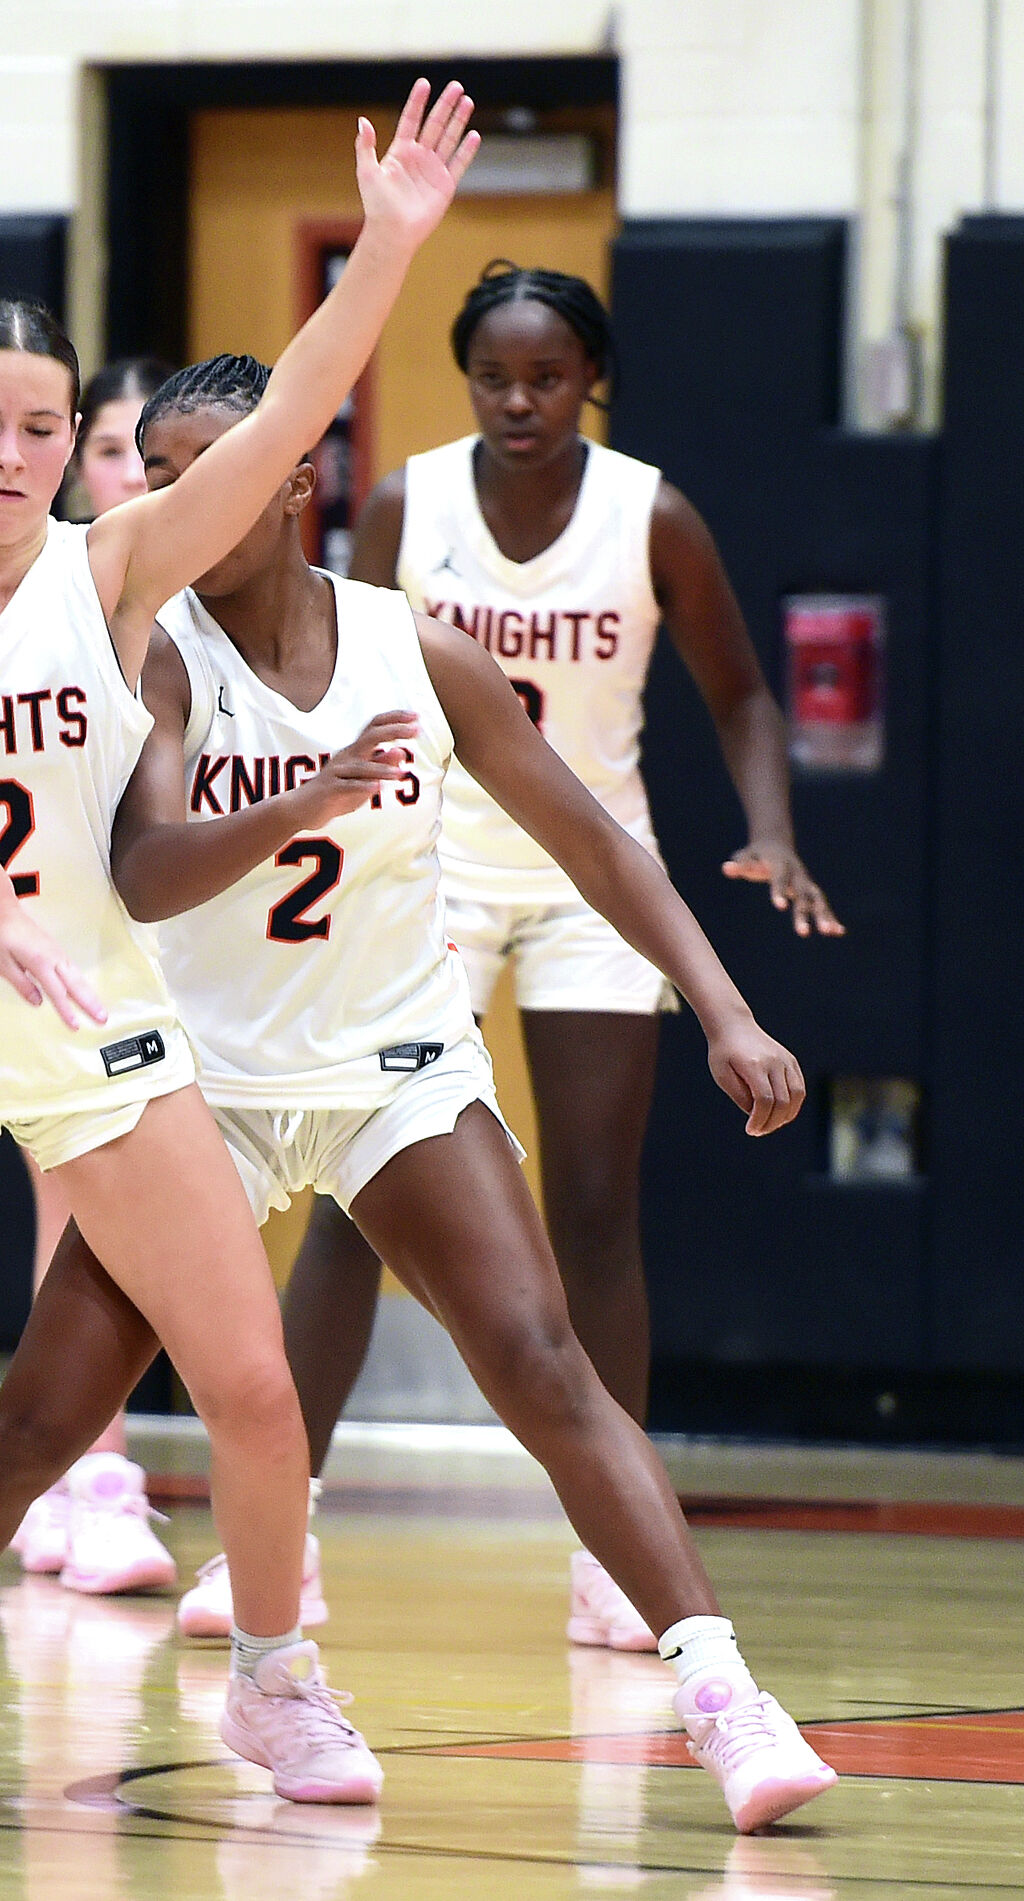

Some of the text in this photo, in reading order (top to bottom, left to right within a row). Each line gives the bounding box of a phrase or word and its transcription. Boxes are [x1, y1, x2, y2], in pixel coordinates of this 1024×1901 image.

[190, 746, 420, 815] KNIGS
[266, 836, 344, 944] 2
[146, 1039, 158, 1055] M
